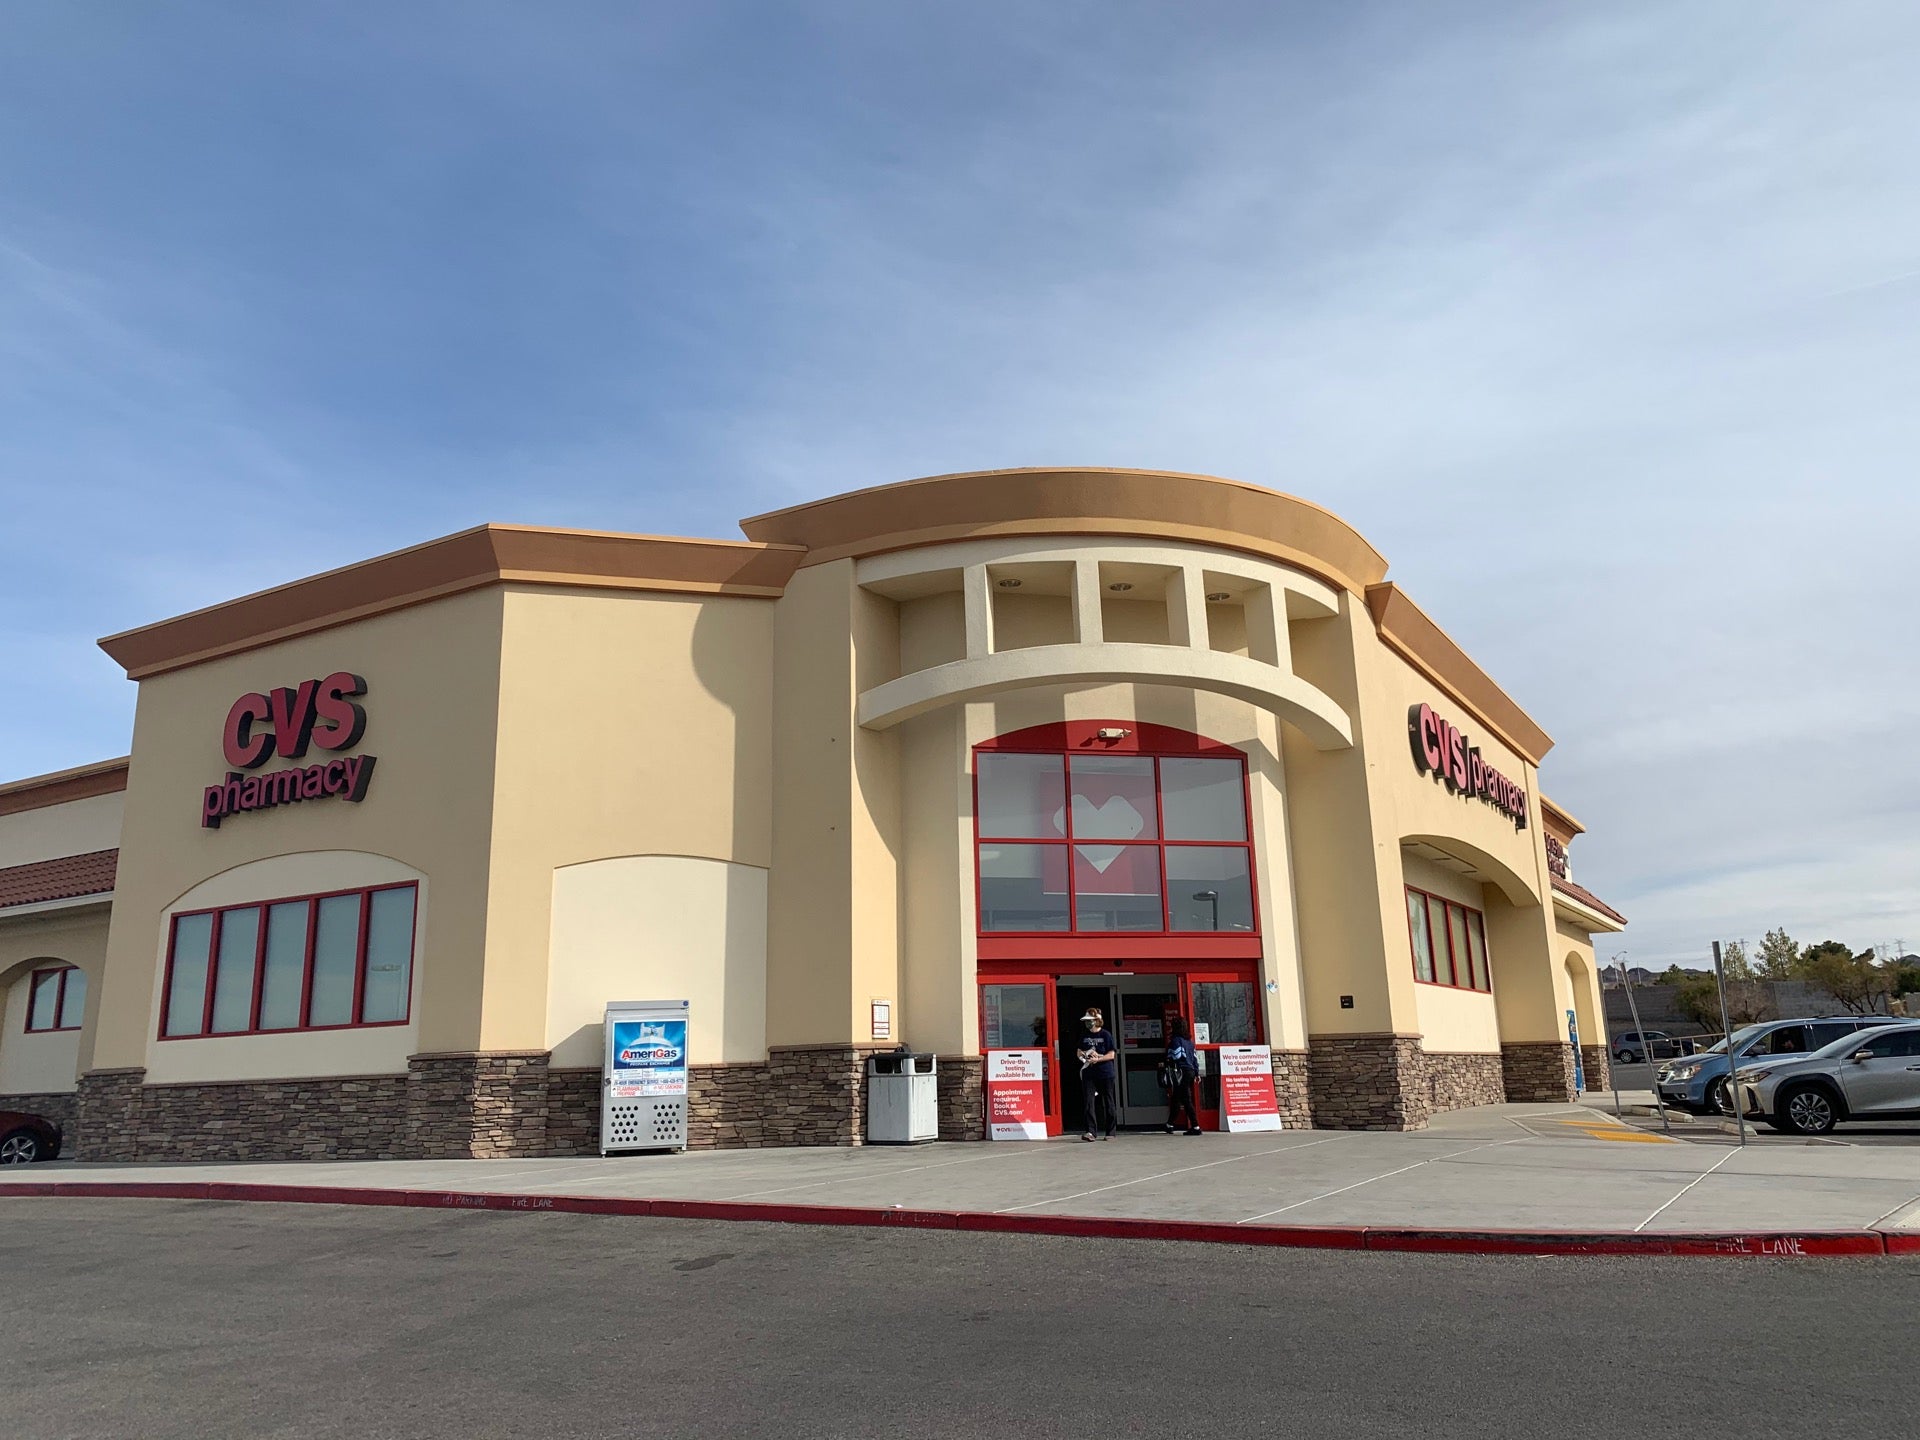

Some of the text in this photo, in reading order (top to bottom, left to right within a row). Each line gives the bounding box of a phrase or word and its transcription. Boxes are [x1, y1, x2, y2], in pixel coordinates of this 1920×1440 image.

[223, 671, 364, 768] CVS
[202, 754, 374, 828] pharmacy
[622, 1048, 677, 1059] AmeriGas
[993, 1089, 1033, 1097] Appointment
[512, 1197, 554, 1208] FIRE LANE
[1762, 1238, 1806, 1255] LANE
